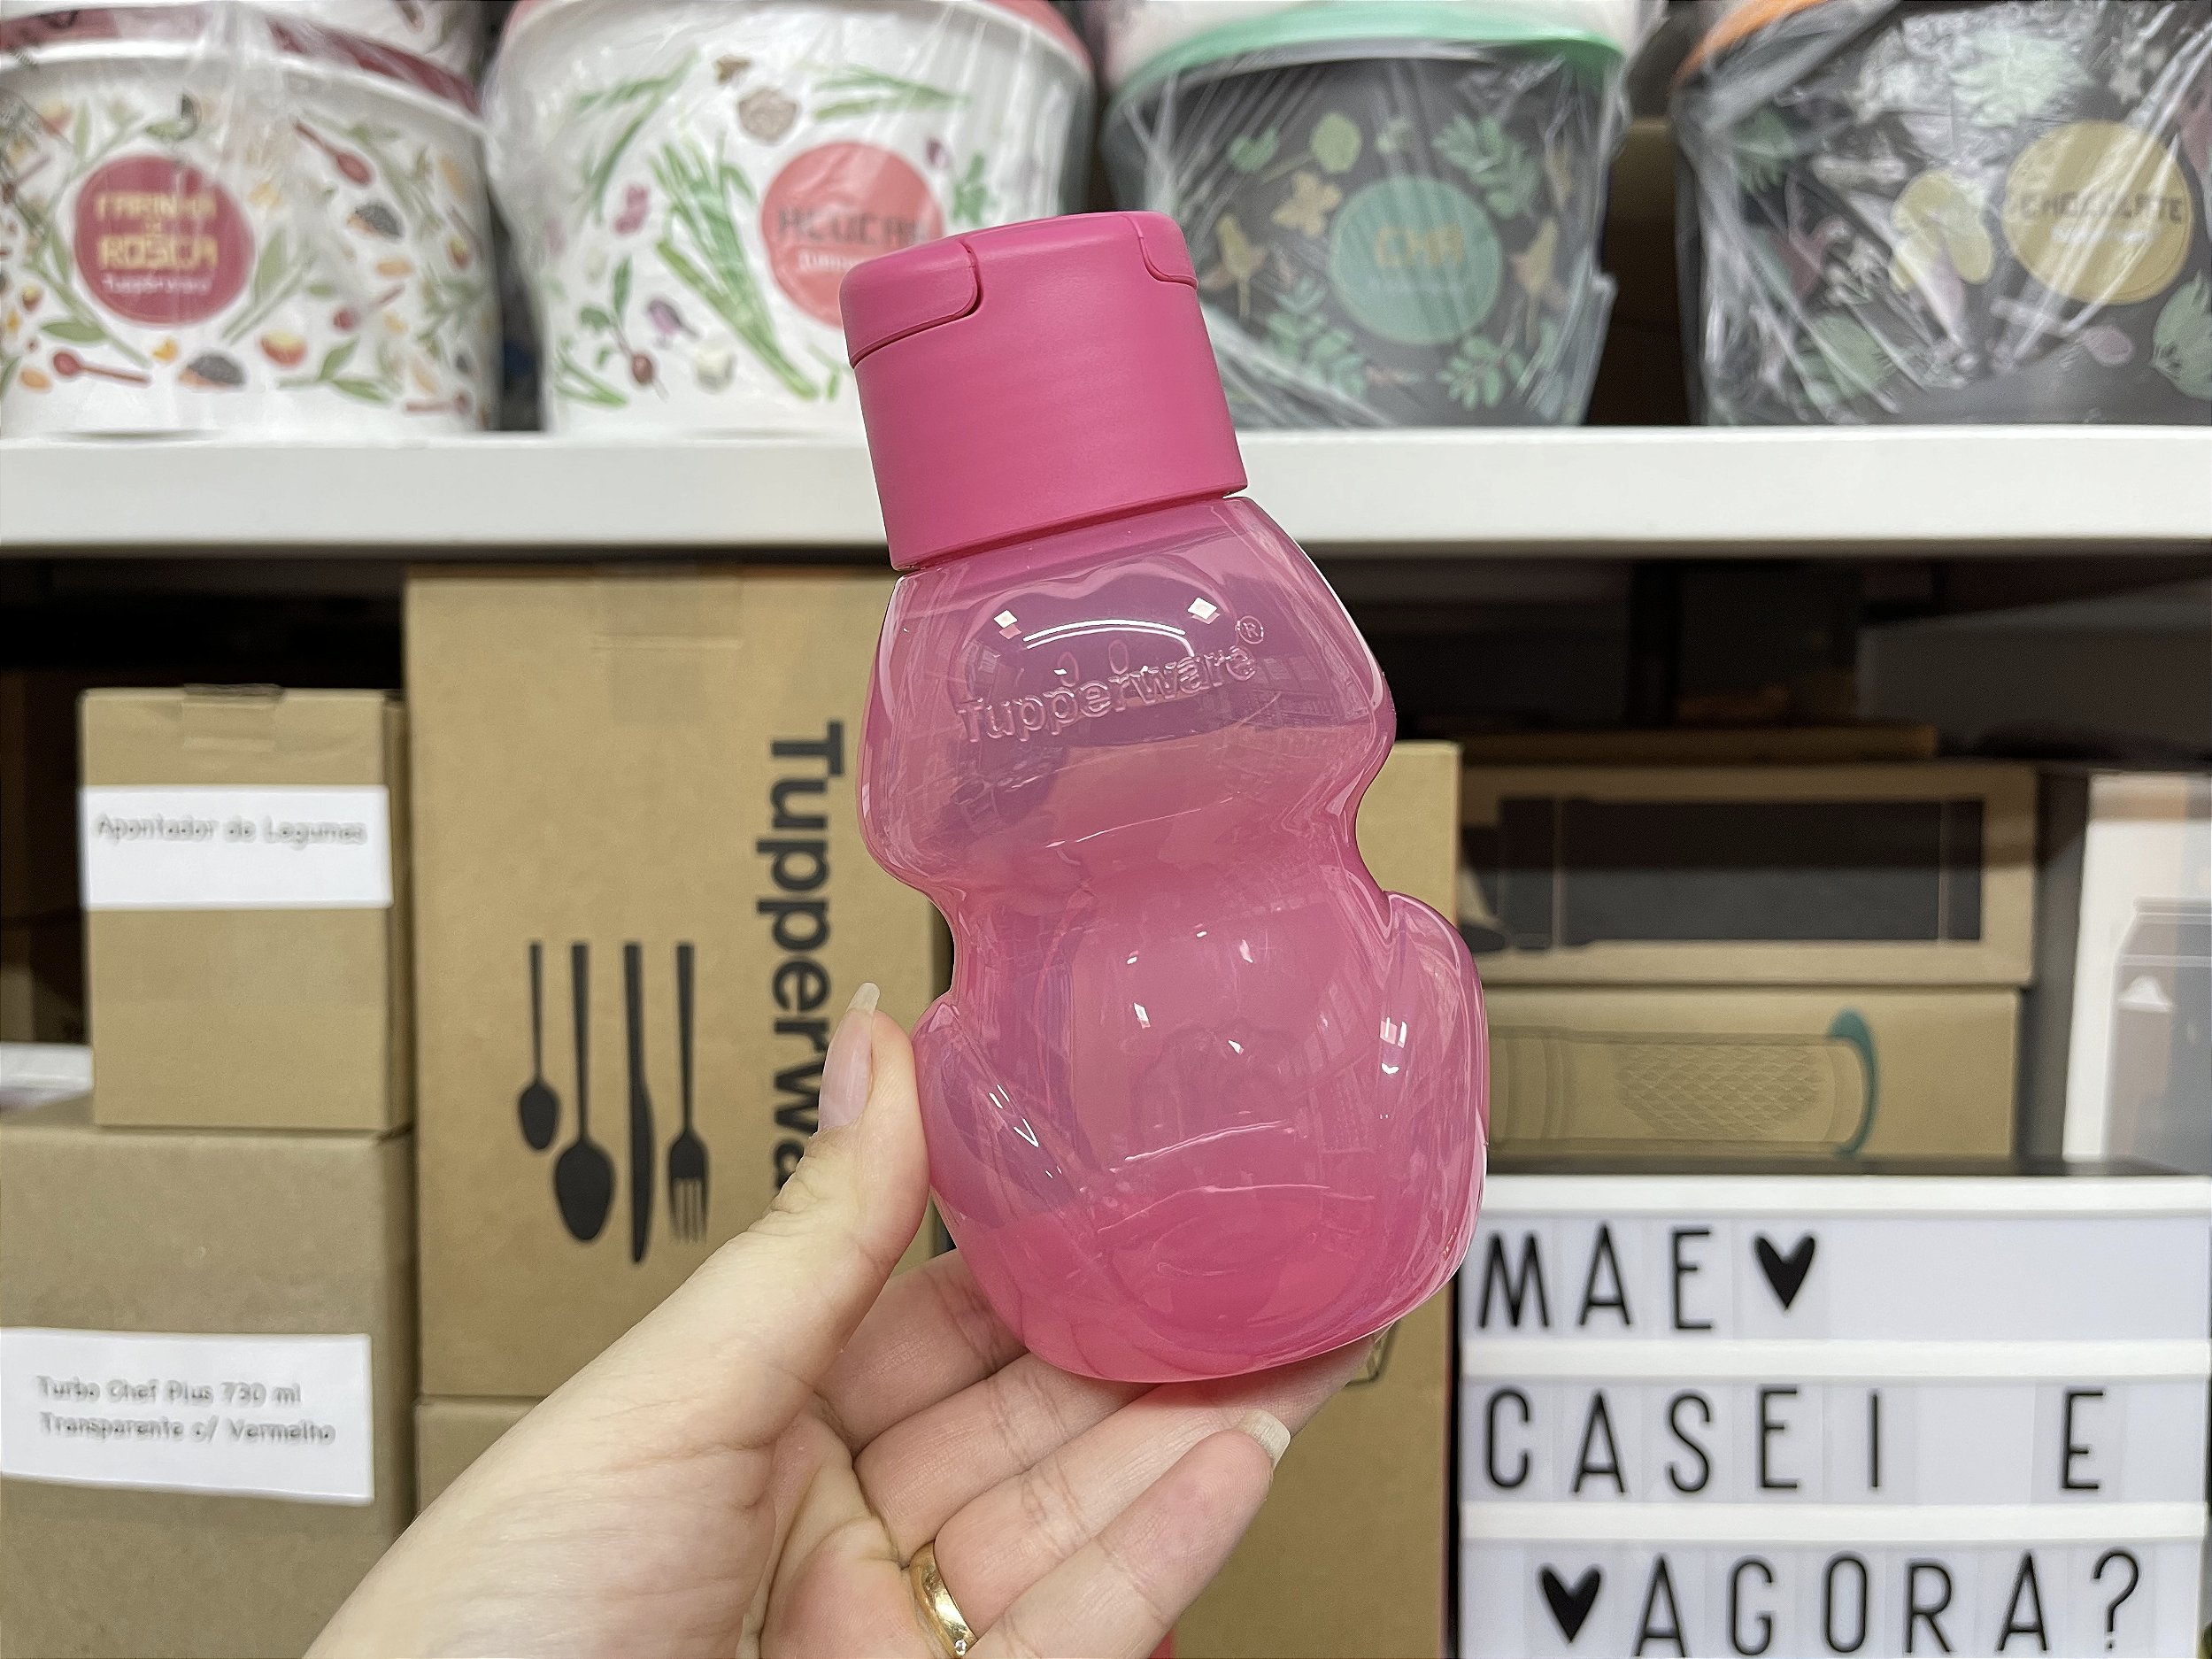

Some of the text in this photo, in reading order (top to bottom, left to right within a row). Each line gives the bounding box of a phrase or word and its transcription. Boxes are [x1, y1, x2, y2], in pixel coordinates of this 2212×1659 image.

[92, 814, 366, 851] Apontador de Legumes
[1478, 1222, 1715, 1331] MAE
[36, 1375, 302, 1408] Turbo Chef Plus 730 ml
[39, 1412, 336, 1446] Transparente c/ Vermelho
[1484, 1386, 2107, 1494] CASEI E
[1633, 1547, 2142, 1658] AGORA?
